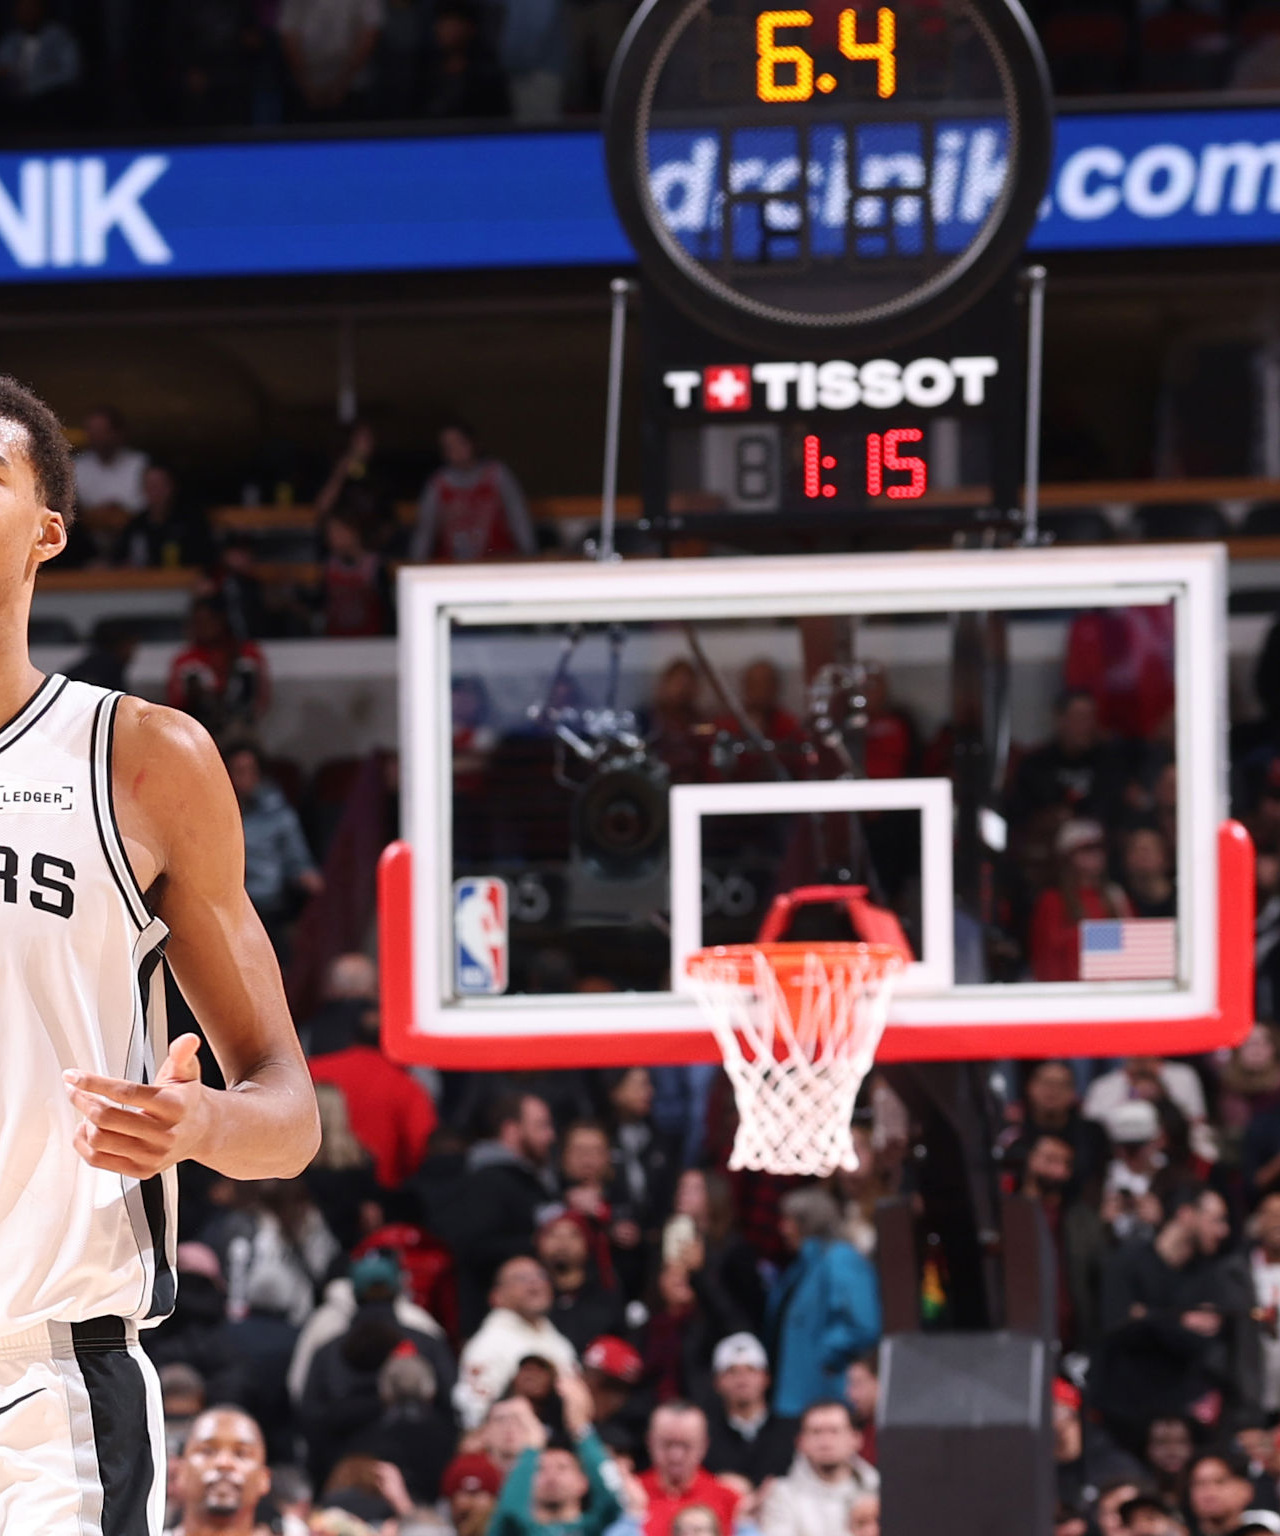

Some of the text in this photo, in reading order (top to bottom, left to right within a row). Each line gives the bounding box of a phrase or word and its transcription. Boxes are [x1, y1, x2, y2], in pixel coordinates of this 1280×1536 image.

[756, 7, 896, 103] 6.4
[752, 356, 999, 411] TISSOT
[2, 791, 63, 804] LEDGER
